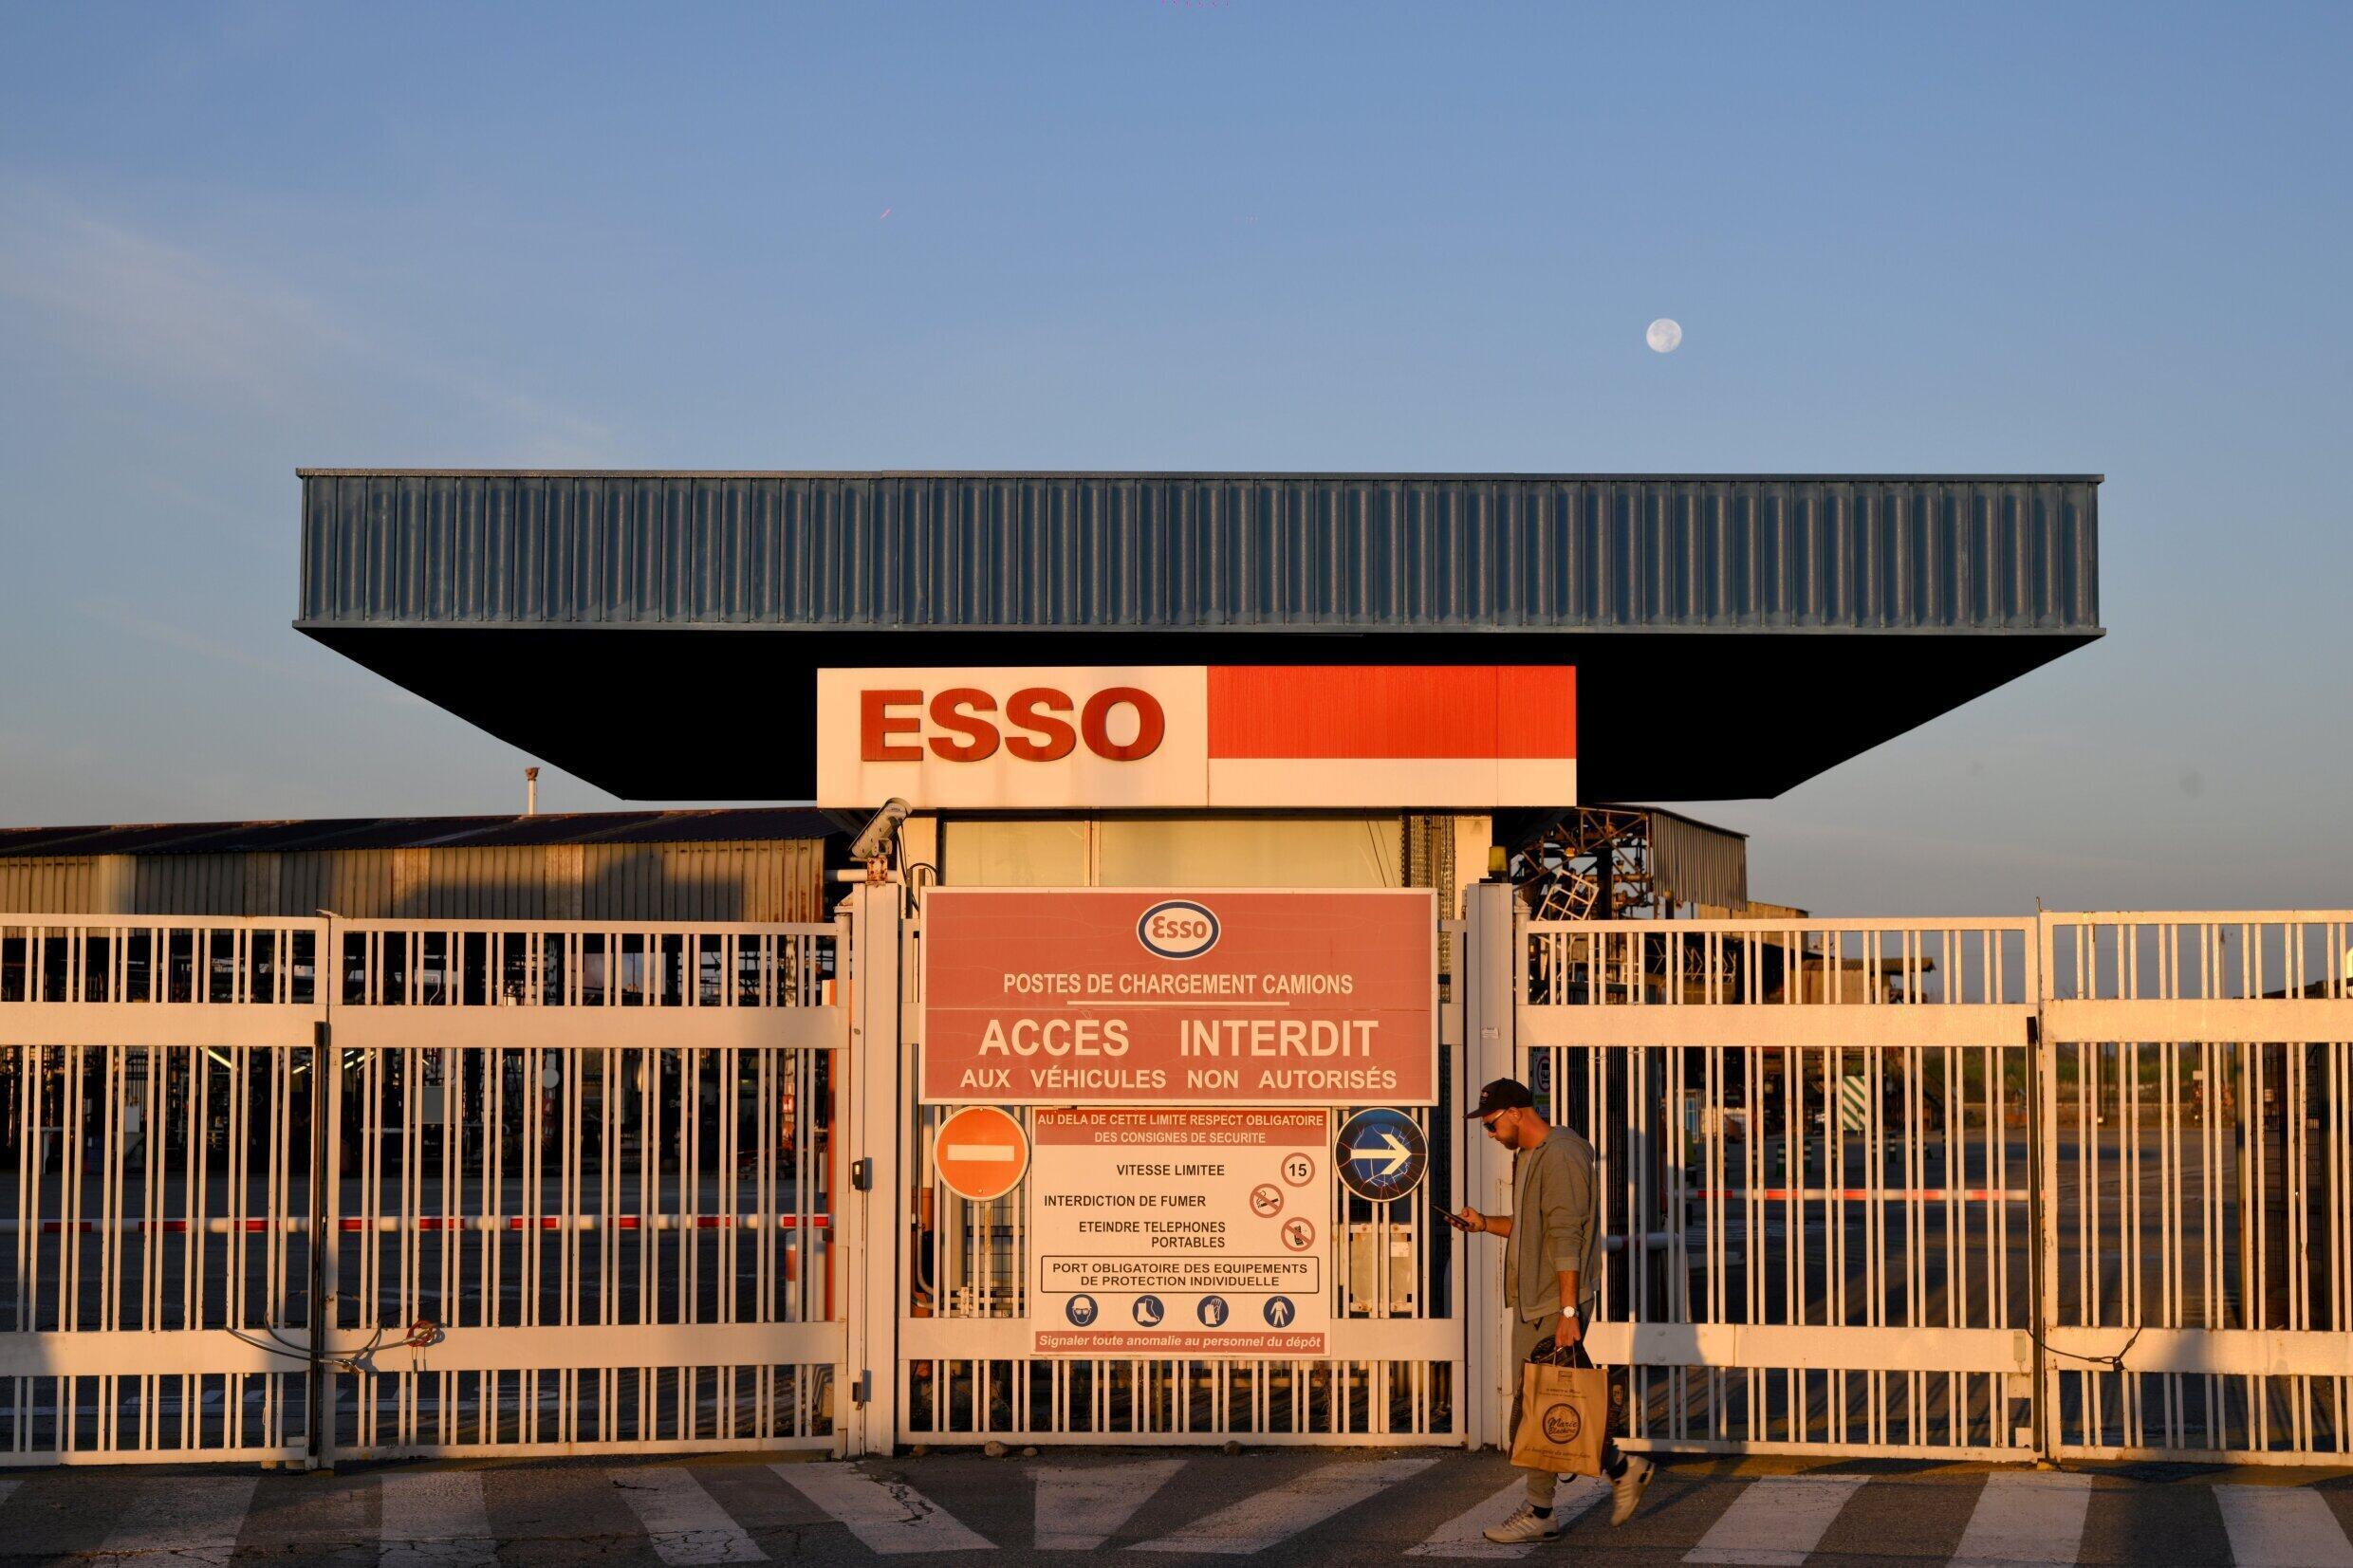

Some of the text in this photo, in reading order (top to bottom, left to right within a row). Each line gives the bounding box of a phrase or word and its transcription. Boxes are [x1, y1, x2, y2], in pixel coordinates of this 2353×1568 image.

[860, 686, 1165, 763] ESSO
[1152, 915, 1208, 939] Esso
[1003, 972, 1354, 996] POSTES DE CHARGEMENT CAMIONS
[977, 1018, 1380, 1057] ACCES INTERDIT
[959, 1064, 1398, 1090] AUX VÉHICULES NON AUTORISÉS
[1037, 1114, 1324, 1126] AU DELA DE CETTE LIMITE RESPECT OBLIGATOIRE
[1094, 1131, 1267, 1144] DES CONSIGNES DE SECURITE
[1116, 1164, 1225, 1176] VITESSE LIMITEE
[1288, 1163, 1307, 1177] 15
[1044, 1194, 1207, 1208] INTERDICTION DE FUMER
[1079, 1221, 1226, 1233] ETEINDRE TELEPHONES
[1151, 1236, 1226, 1248] PORTABLES
[1052, 1263, 1307, 1275] PORT OBLIGATOIRE DES EQUIPEMENTS
[1081, 1276, 1280, 1286] DE PROTECTION INDIVIDUELLE
[1039, 1335, 1322, 1350] Signaler toute anomalie au personnel du dépôt
